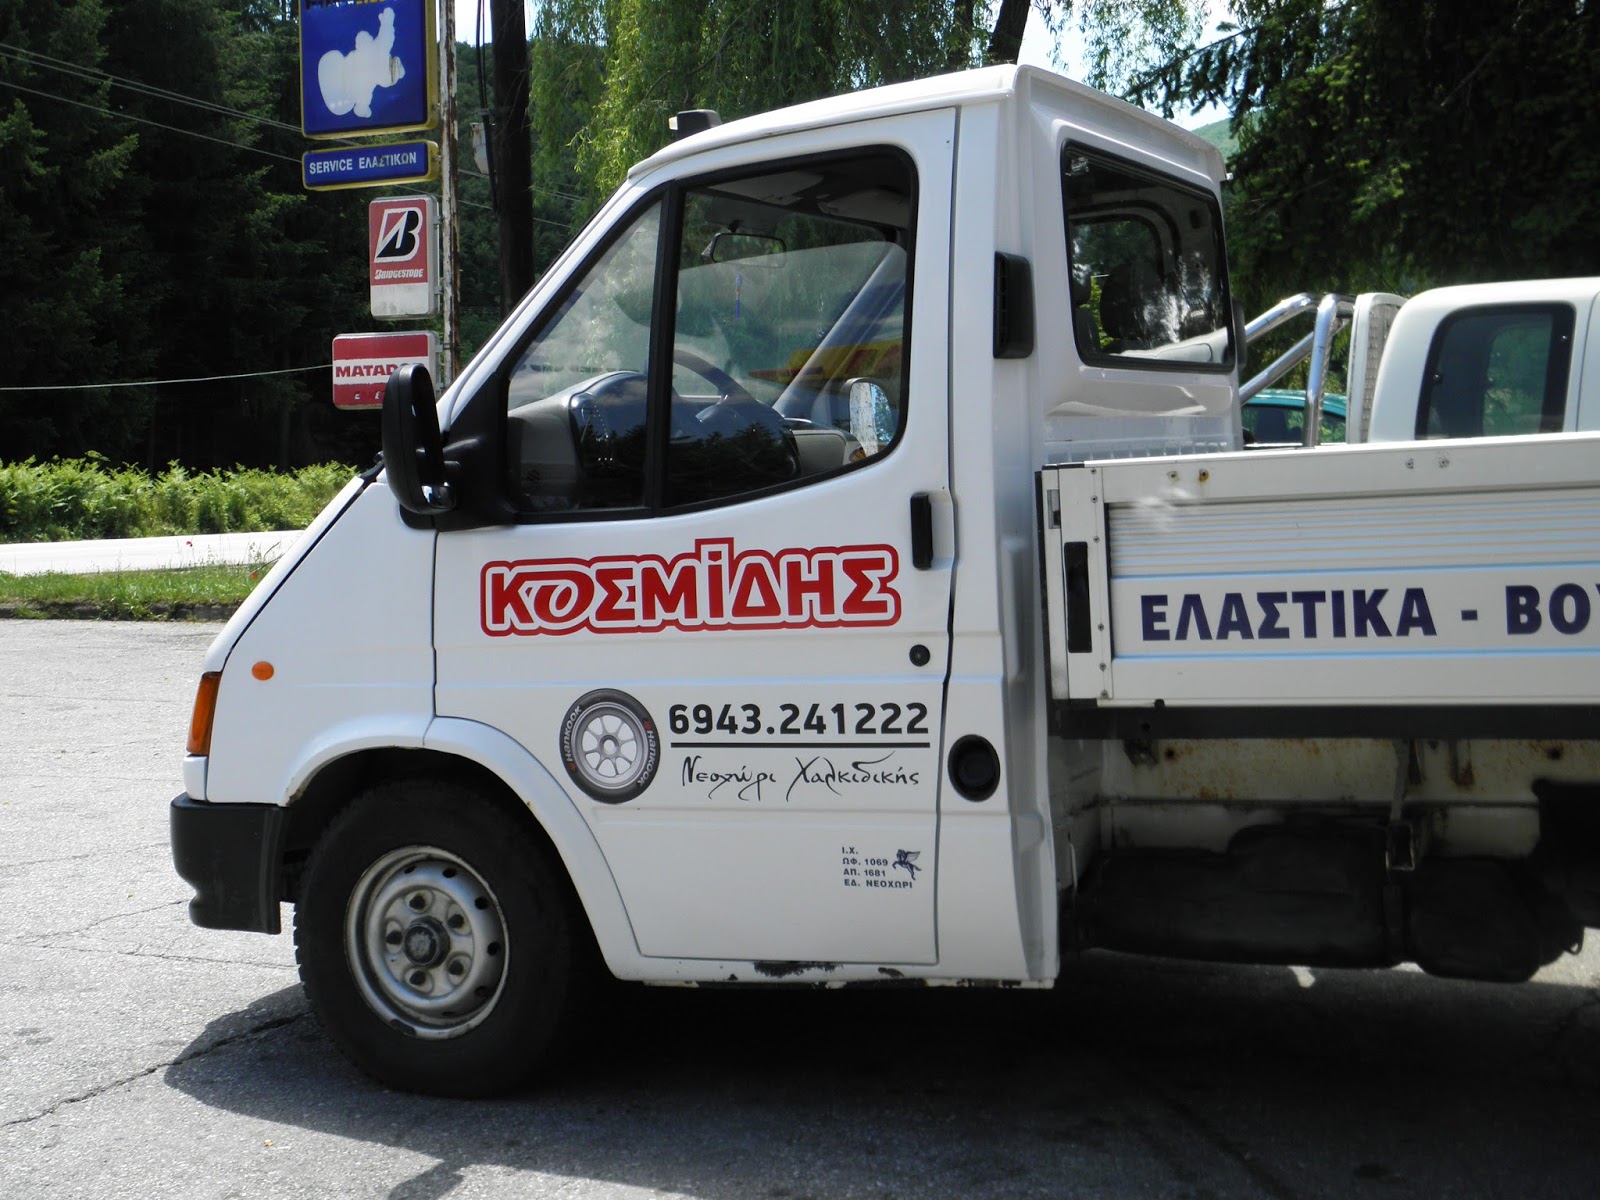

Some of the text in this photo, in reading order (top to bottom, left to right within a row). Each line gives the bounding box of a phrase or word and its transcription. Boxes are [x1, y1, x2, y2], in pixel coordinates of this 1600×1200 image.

[309, 151, 417, 175] SERVICE ΕΛΑΣΤΙΚΩΝ
[335, 363, 399, 378] MATAD
[1140, 588, 1437, 641] ΕΛΑΣΤΙΚΑ
[1505, 582, 1600, 635] ΒΟ
[669, 702, 929, 735] 6943.241222
[786, 750, 920, 802] Χαλκιδικής
[864, 858, 889, 867] 1069
[864, 869, 886, 877] 1681
[865, 879, 913, 889] ΝΕΟΧΩΡΙ
